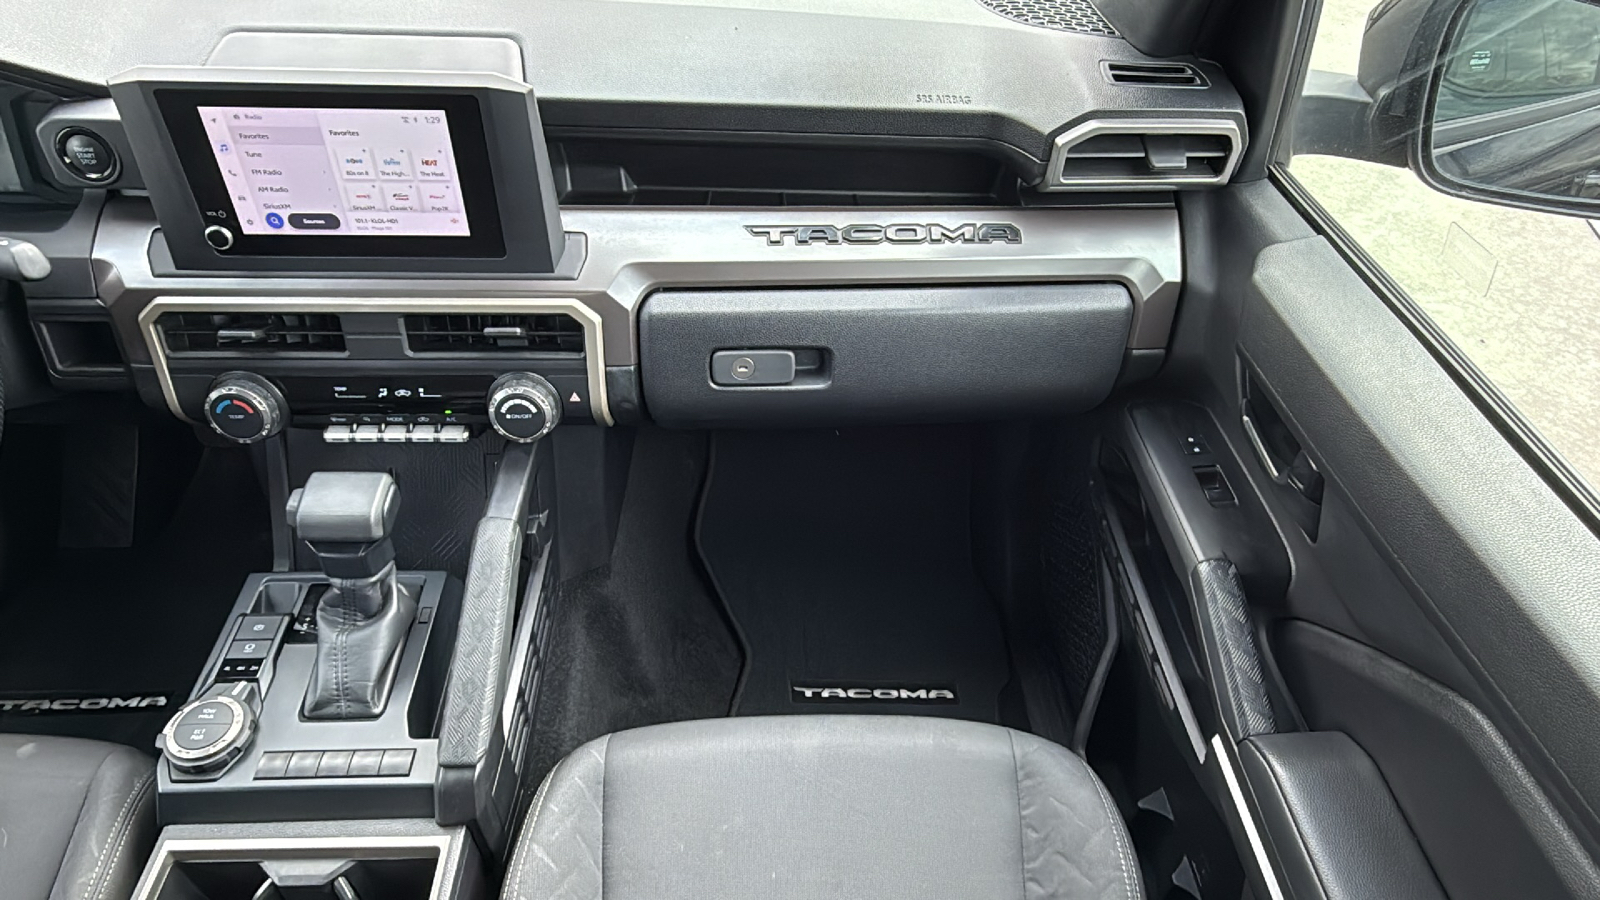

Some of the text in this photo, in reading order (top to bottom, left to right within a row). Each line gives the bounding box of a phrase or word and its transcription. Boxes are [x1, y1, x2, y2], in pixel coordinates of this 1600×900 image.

[916, 94, 971, 104] SRS AIRBAG
[424, 116, 441, 124] 1:29
[742, 223, 1023, 246] TACOMA
[793, 686, 955, 699] TACOMA
[0, 696, 167, 710] TACOMA
